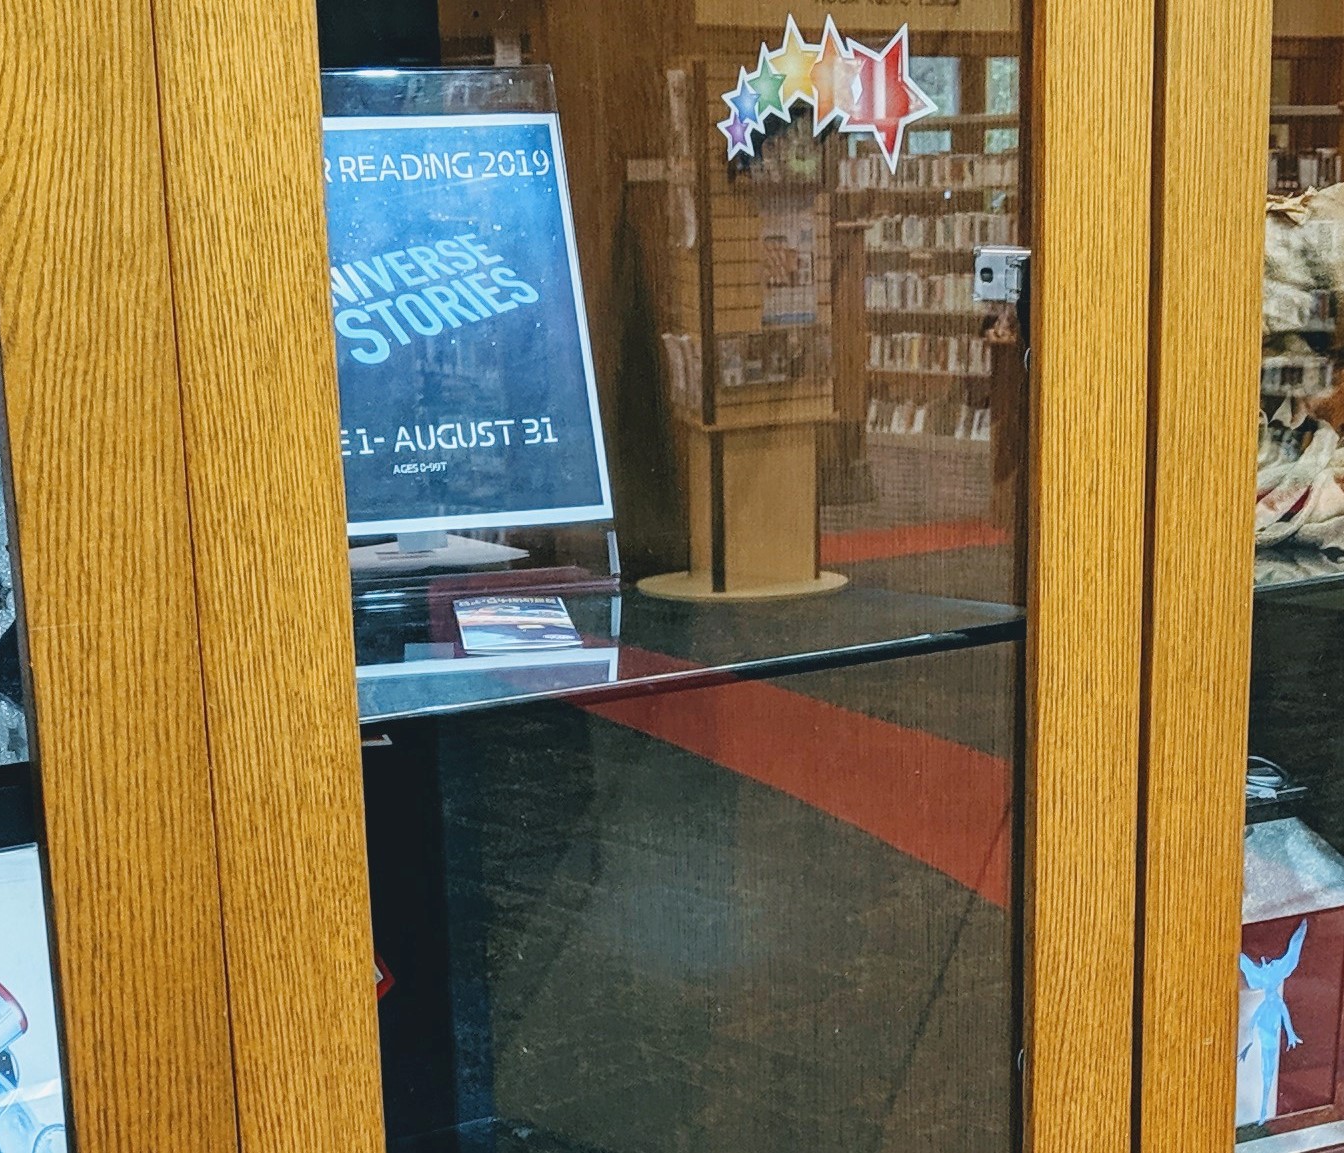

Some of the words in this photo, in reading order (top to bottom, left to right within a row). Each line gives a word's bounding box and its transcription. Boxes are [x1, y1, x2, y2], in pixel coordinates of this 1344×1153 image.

[339, 151, 471, 182] READING
[477, 149, 550, 179] 2019
[334, 266, 540, 364] STORIES
[394, 418, 515, 453] AUGUST
[521, 416, 558, 445] 31
[393, 462, 419, 475] AGES
